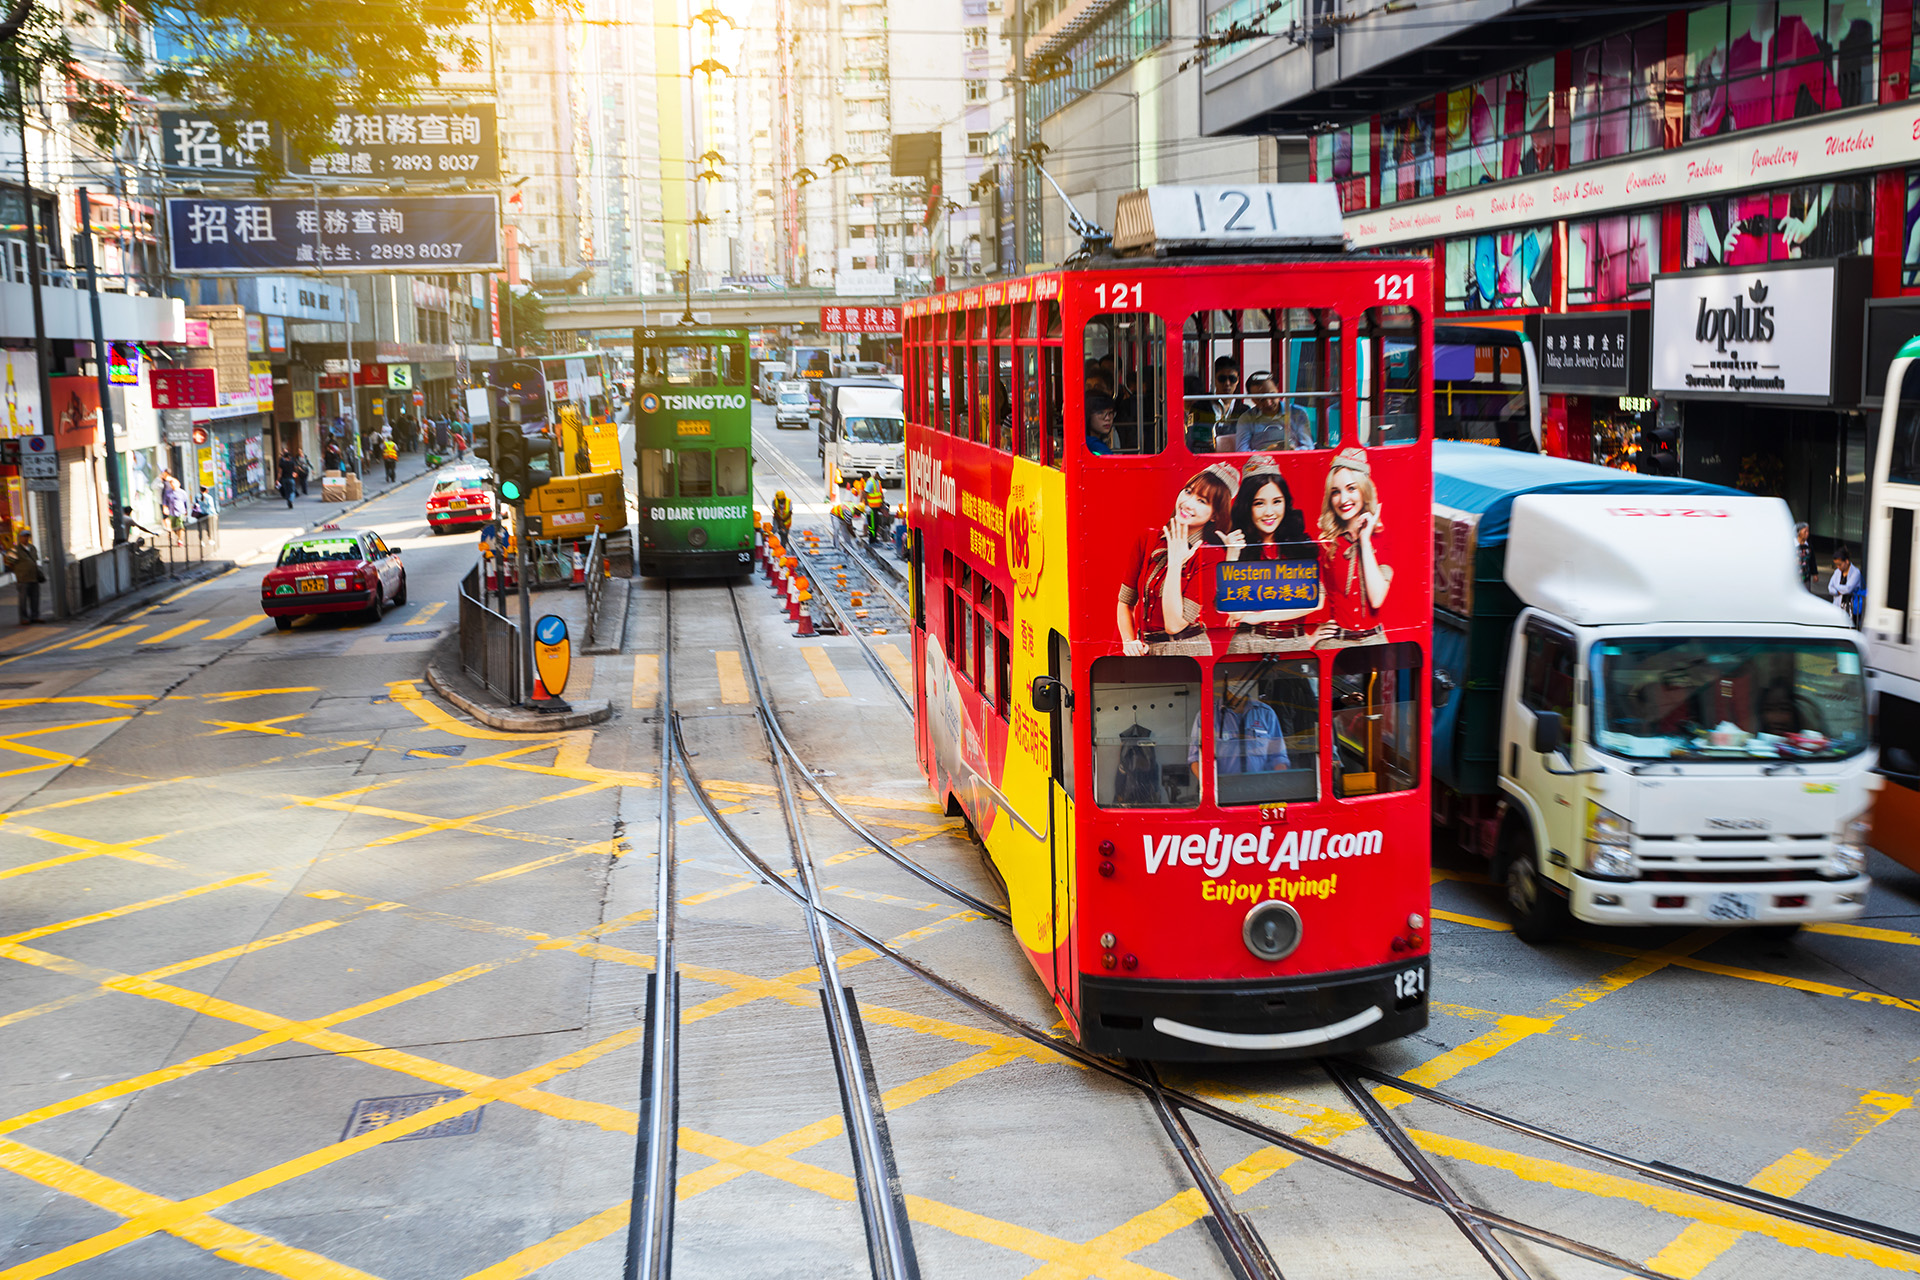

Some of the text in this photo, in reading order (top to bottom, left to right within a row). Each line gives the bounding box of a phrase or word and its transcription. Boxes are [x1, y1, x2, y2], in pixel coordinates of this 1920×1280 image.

[1825, 128, 1874, 156] Watches
[391, 154, 433, 171] 2893
[438, 154, 480, 171] 8037
[1686, 158, 1724, 183] Fashion
[1750, 147, 1799, 176] Jewellery
[1552, 186, 1571, 206] Bags
[1582, 180, 1604, 199] Shoes
[1625, 171, 1666, 194] Cosmetics
[296, 208, 405, 235] 租務查詢
[1193, 189, 1278, 233] 121
[188, 205, 276, 244] 招租
[370, 243, 416, 260] 2893
[418, 243, 463, 260] 8037
[1094, 281, 1143, 309] 121
[1374, 273, 1415, 300] 121
[826, 307, 896, 325] 港豐找換
[644, 330, 656, 338] 33
[725, 329, 737, 338] 33
[1600, 353, 1611, 368] Co
[1611, 353, 1624, 368] Ltd
[661, 394, 746, 411] TSINGTAO
[651, 505, 748, 521] GO DARE YOURSELF
[1604, 507, 1731, 519] ISUZU
[737, 552, 750, 563] 33
[1221, 564, 1318, 581] Western Market
[1201, 873, 1337, 905] Enjoy Flying!
[1394, 967, 1425, 998] 121
